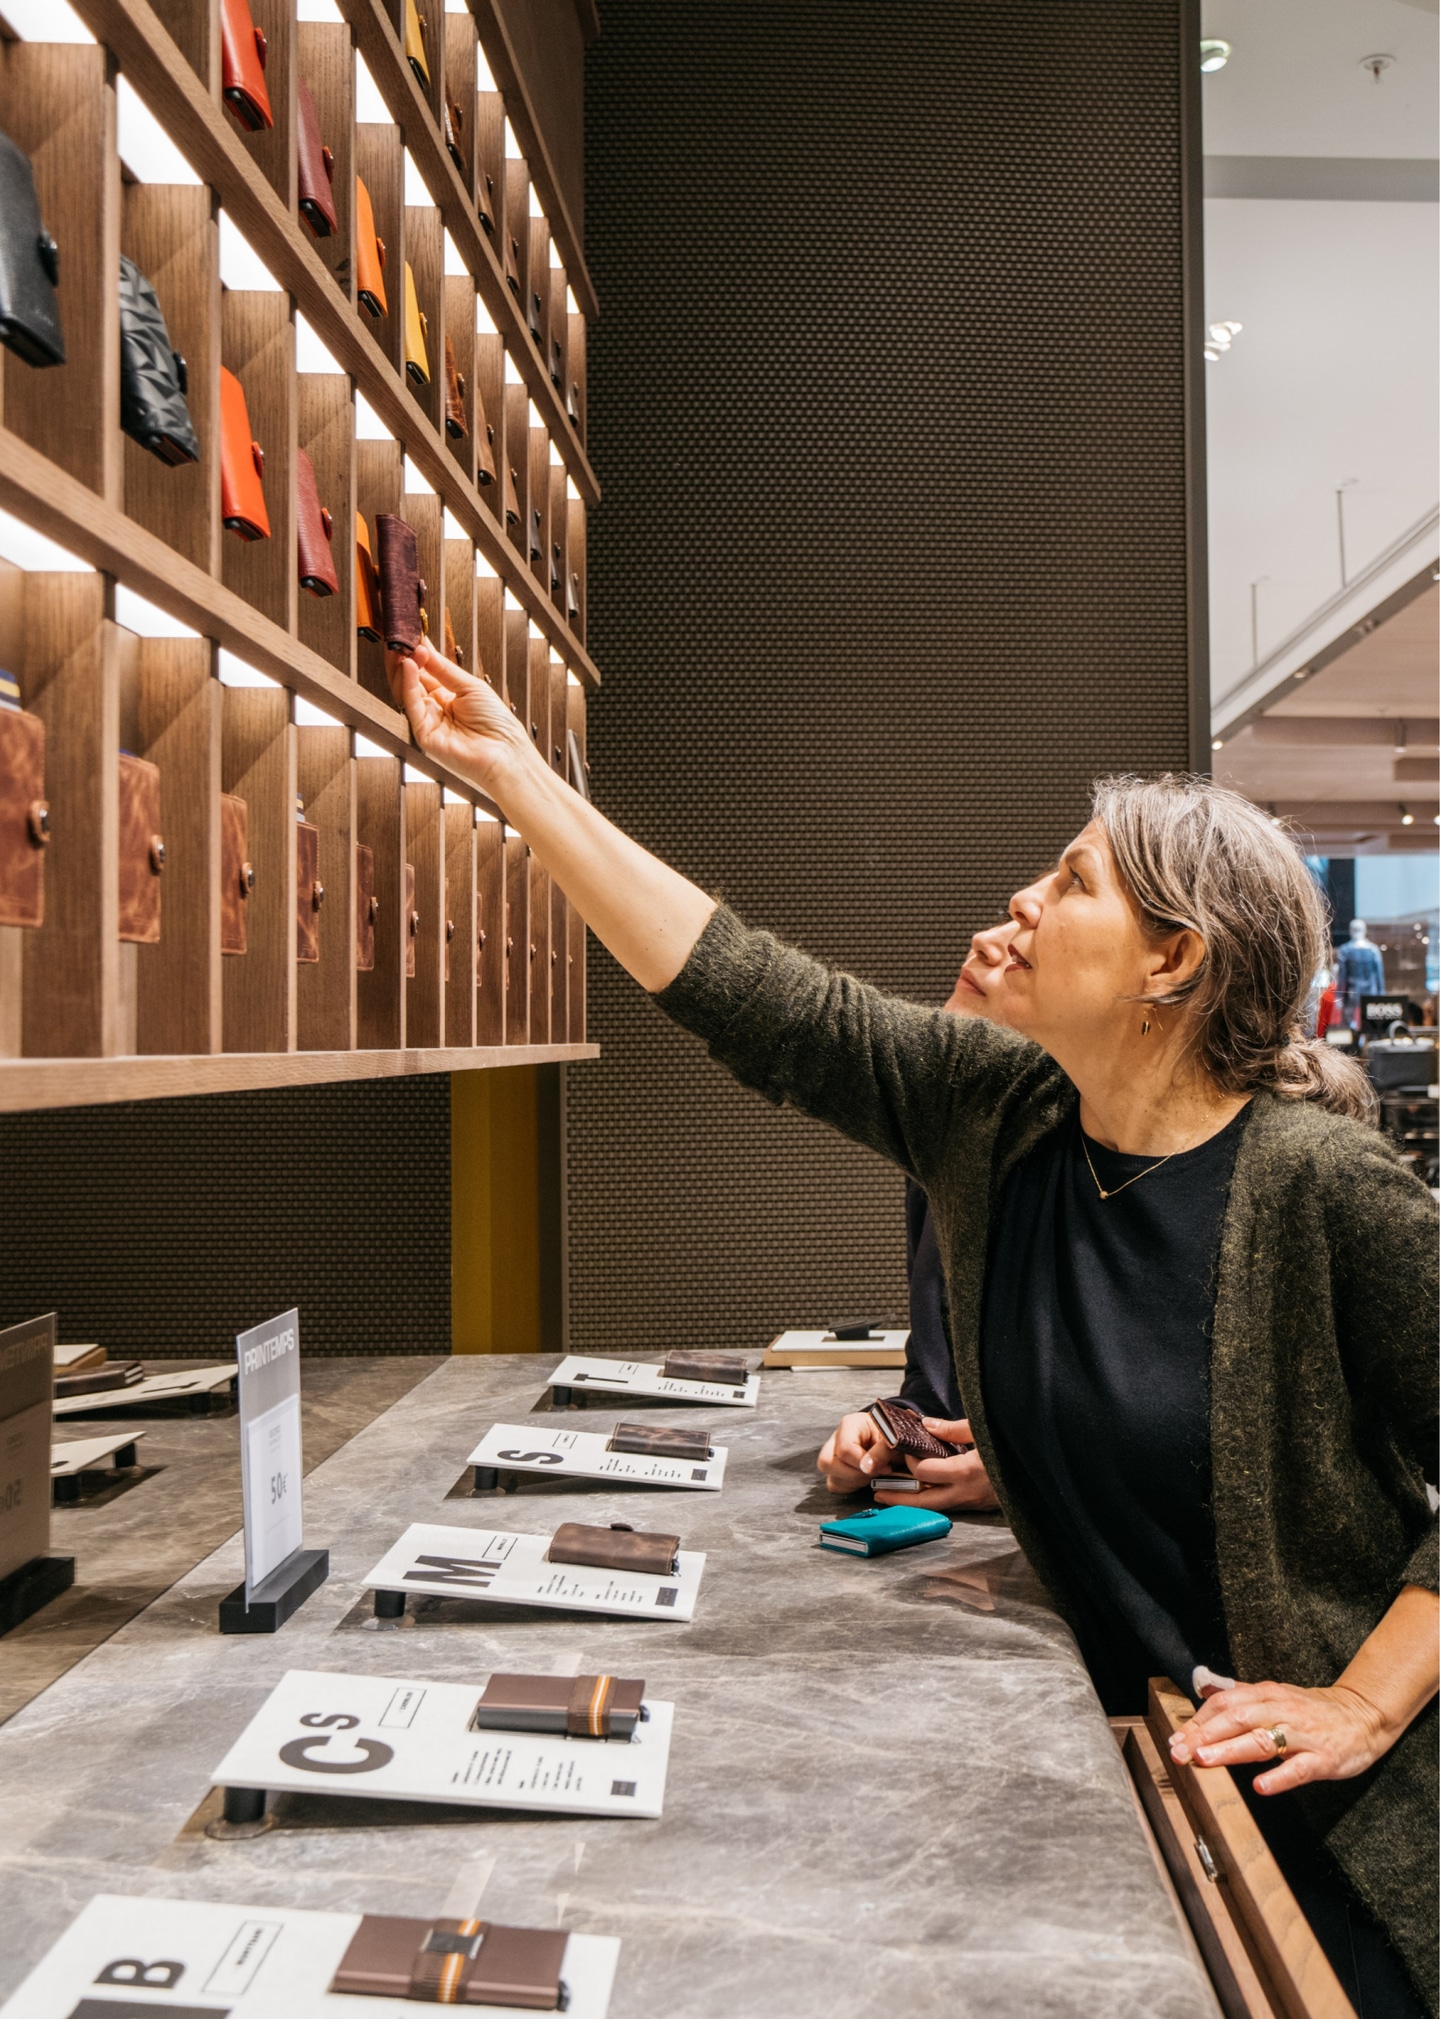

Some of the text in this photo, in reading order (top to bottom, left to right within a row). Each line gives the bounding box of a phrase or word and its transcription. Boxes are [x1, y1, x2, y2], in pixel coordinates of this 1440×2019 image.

[244, 1328, 295, 1375] PRINTEMPS
[497, 1449, 564, 1465] S
[402, 1554, 502, 1588] M
